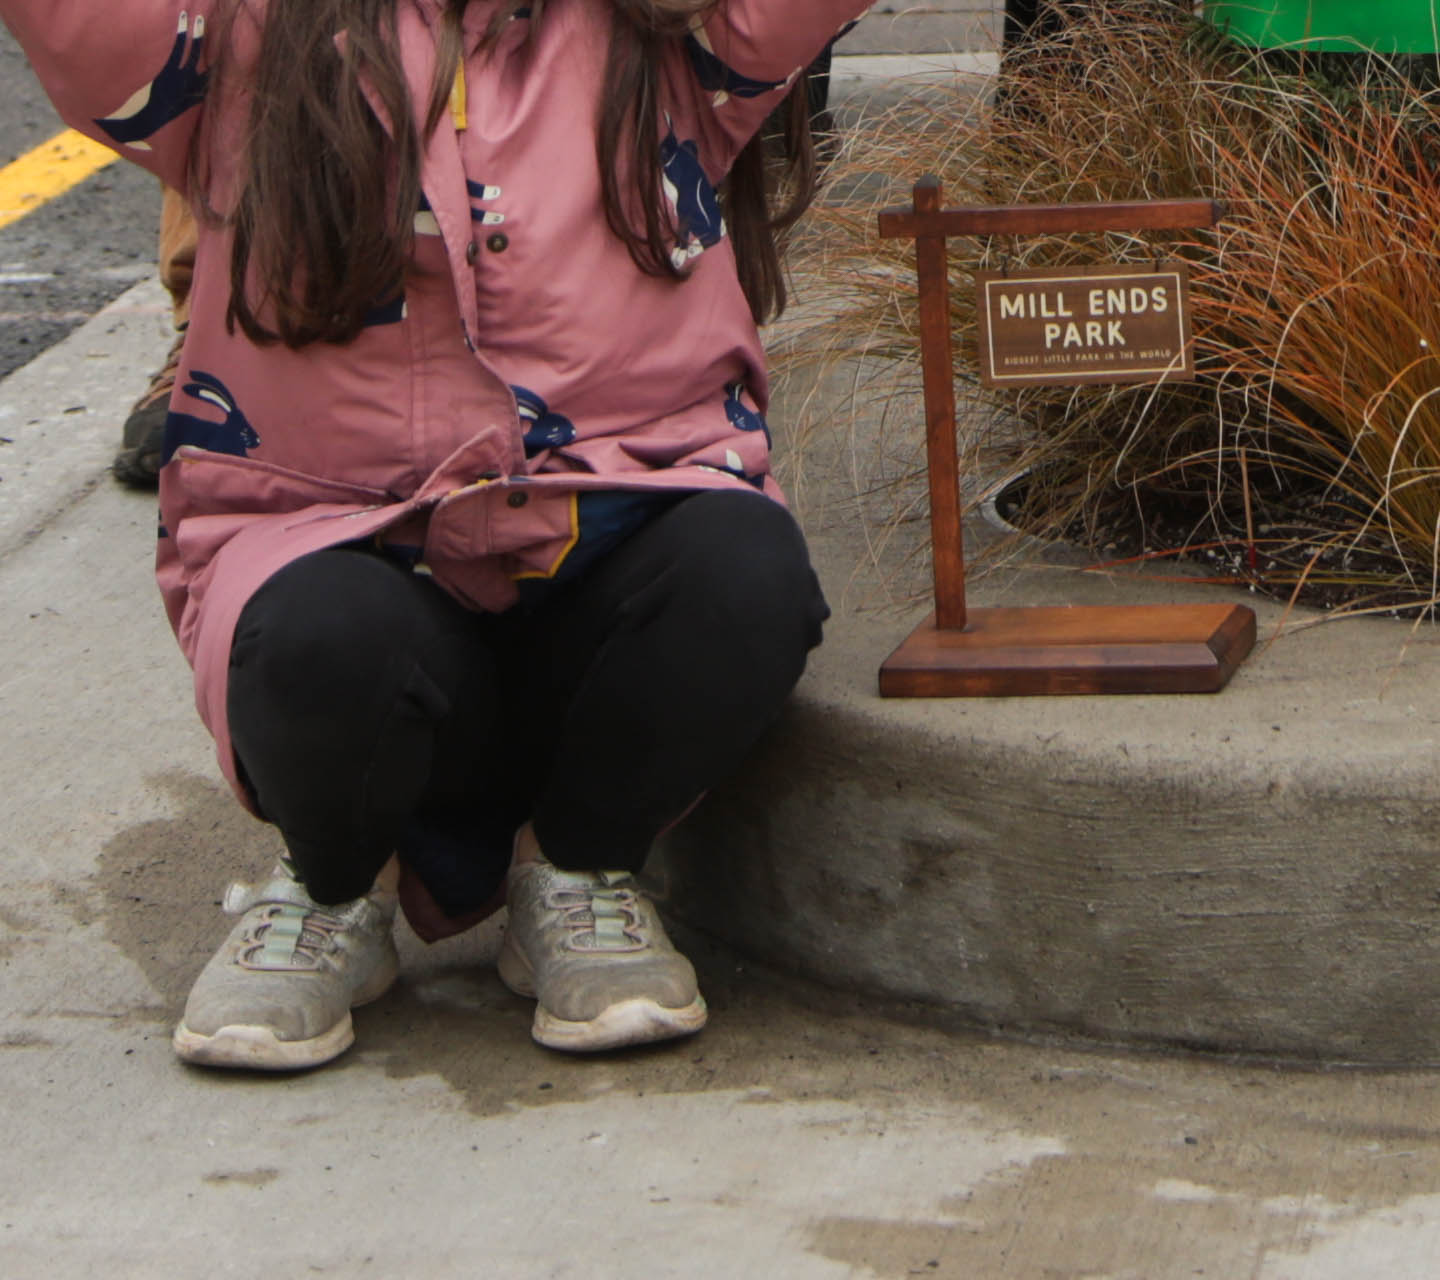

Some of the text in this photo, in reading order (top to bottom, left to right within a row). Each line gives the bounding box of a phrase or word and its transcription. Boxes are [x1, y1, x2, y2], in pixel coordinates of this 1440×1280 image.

[1000, 286, 1168, 319] MILL ENDS
[1045, 320, 1126, 349] PARK
[1004, 348, 1171, 365] BIGGEST LITTLE PARK IN THE WORLD
